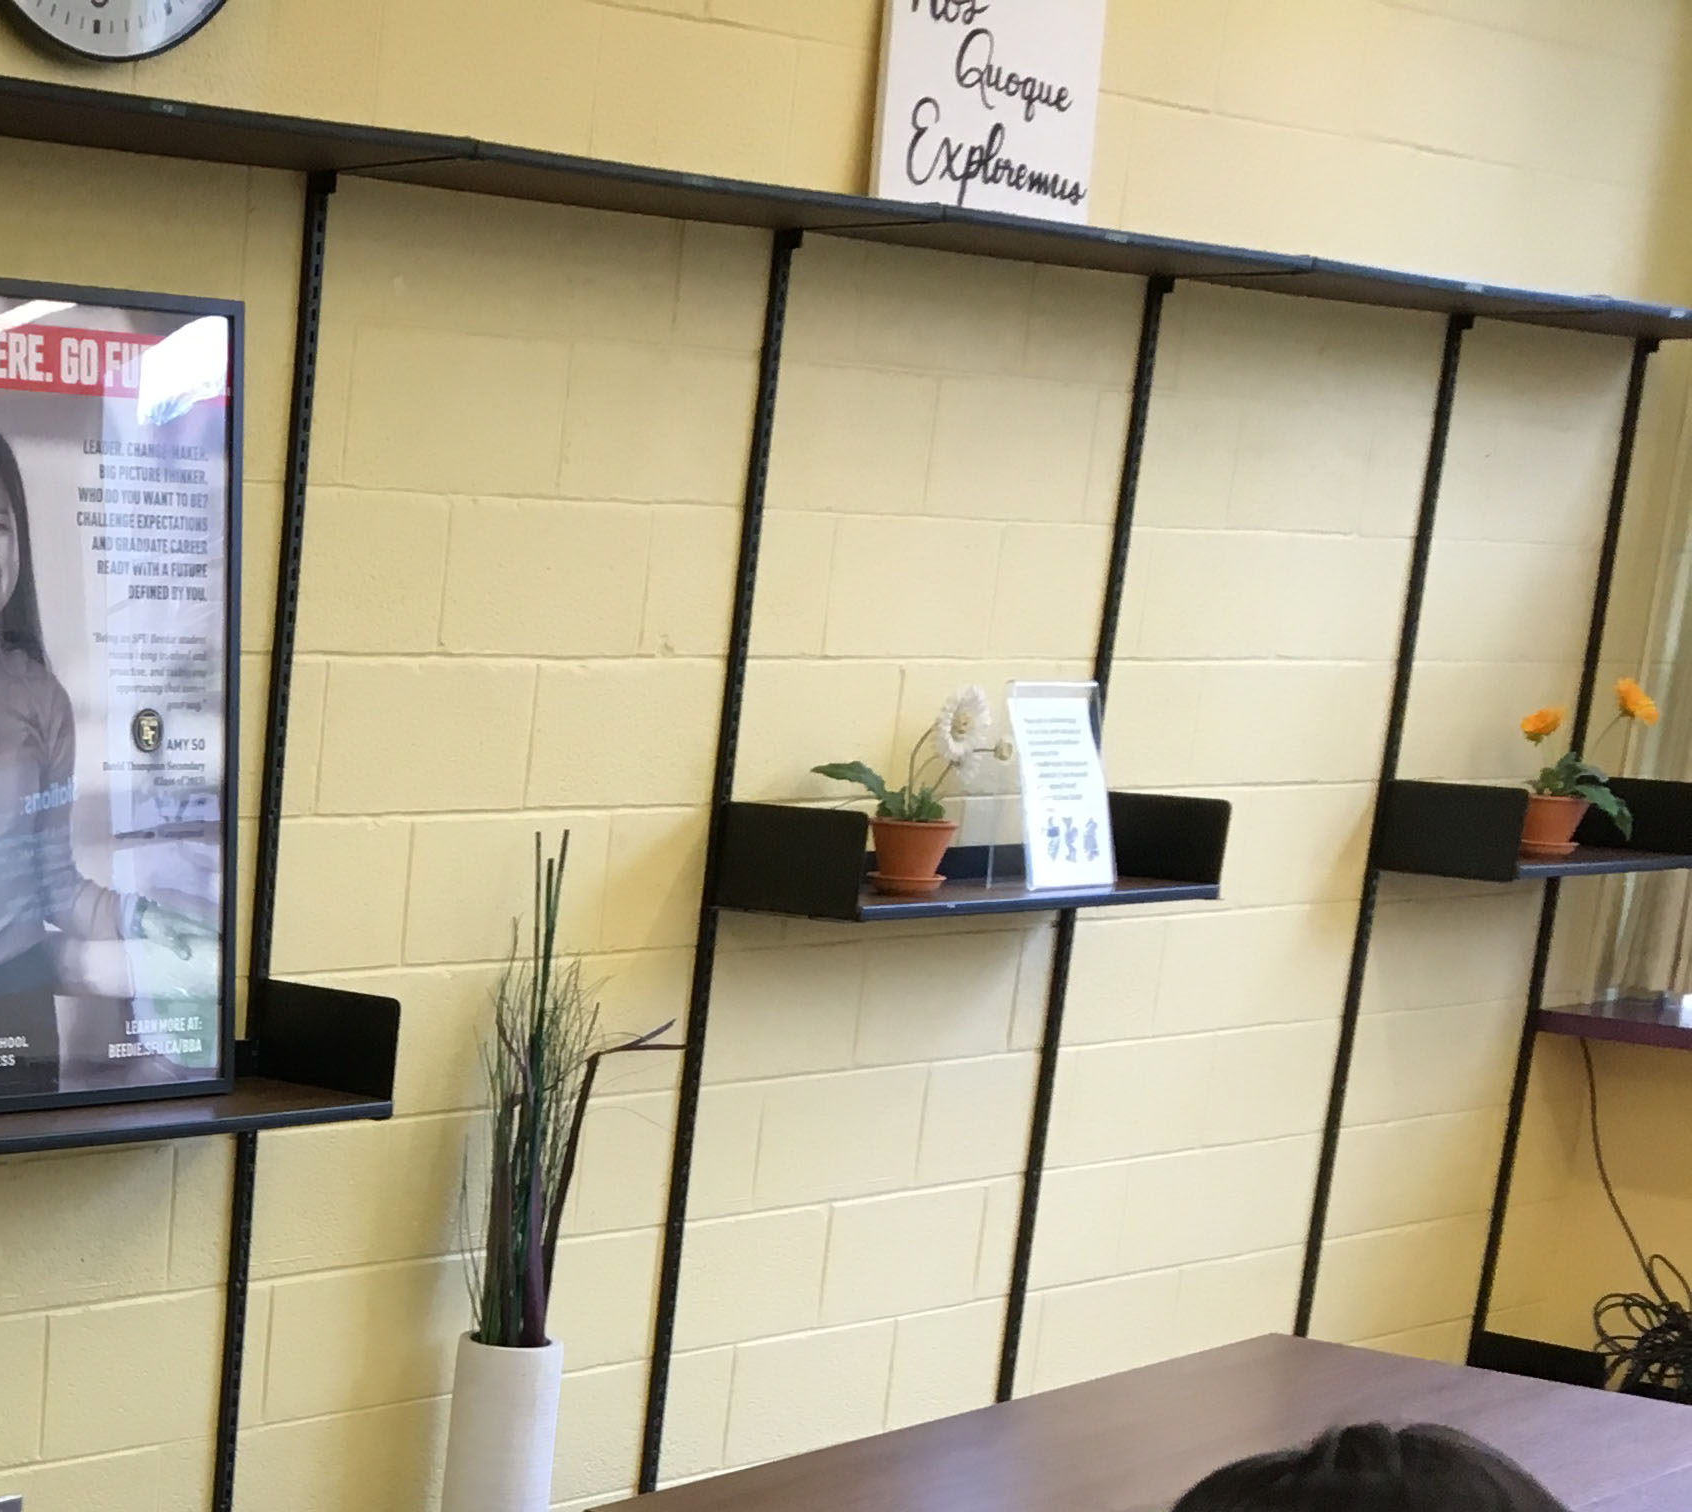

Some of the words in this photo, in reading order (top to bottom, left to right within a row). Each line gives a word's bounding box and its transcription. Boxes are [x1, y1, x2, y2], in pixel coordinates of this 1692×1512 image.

[956, 27, 1073, 123] Quoque
[906, 96, 1088, 208] Exploremus
[60, 336, 98, 388] GO
[77, 486, 103, 503] WHO
[120, 489, 141, 505] YOU
[142, 491, 174, 508] WANT
[176, 492, 189, 508] TO
[76, 511, 135, 529] CHALLENGE
[136, 513, 208, 532] EXPECTATIONS
[97, 559, 130, 576] READY
[128, 584, 169, 600] DEFINED
[166, 738, 190, 751] AMY
[191, 738, 206, 751] SO
